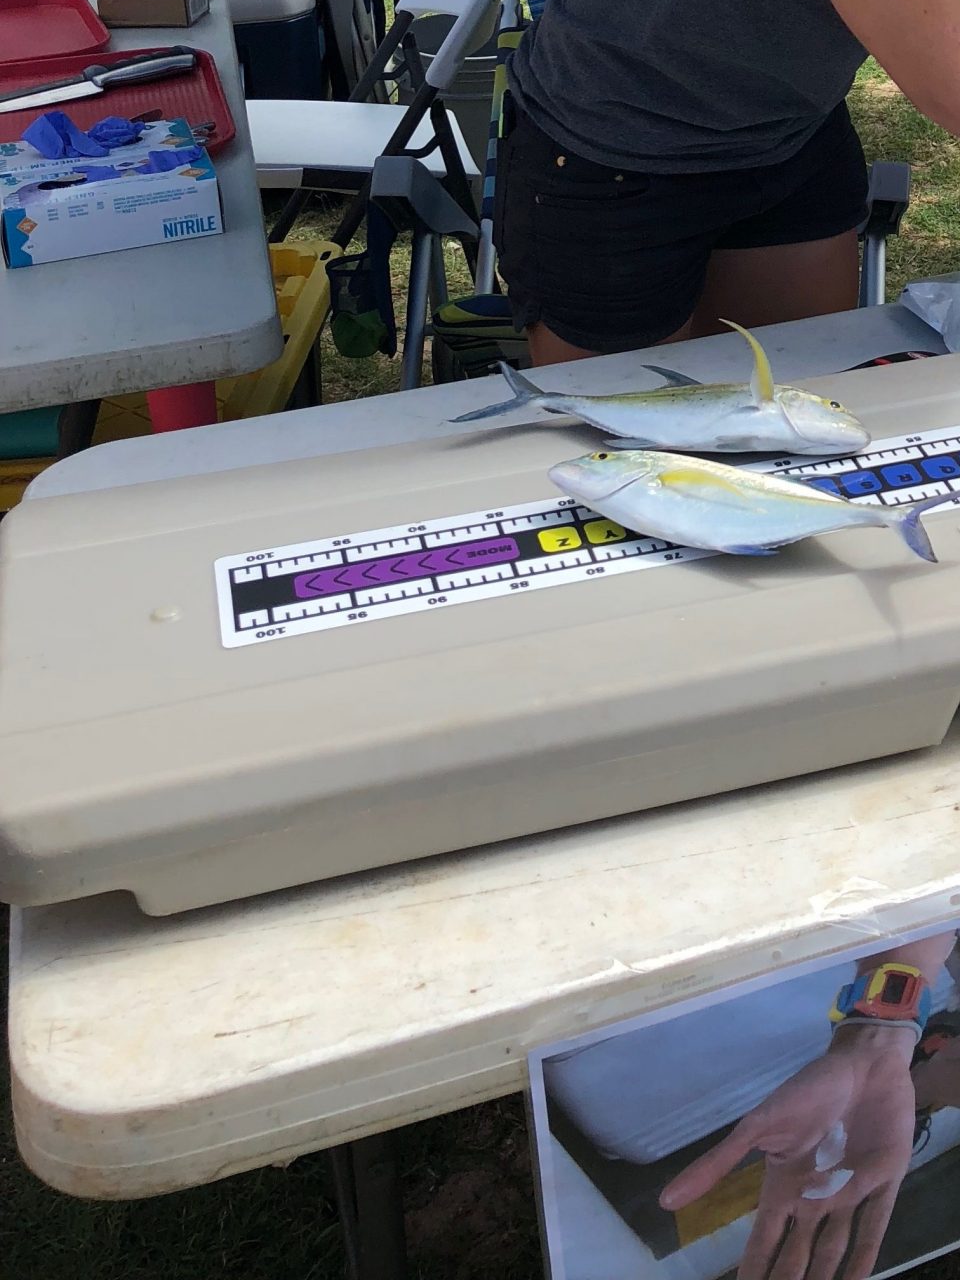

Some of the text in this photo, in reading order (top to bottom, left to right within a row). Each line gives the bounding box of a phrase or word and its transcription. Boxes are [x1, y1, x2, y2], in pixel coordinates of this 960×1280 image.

[163, 215, 217, 239] NITRILE
[558, 498, 576, 507] 80
[486, 511, 504, 519] 85
[407, 524, 427, 533] 90
[604, 529, 620, 539] Y
[332, 538, 352, 547] 95
[556, 538, 571, 548] Z
[467, 543, 513, 559] MODE
[246, 552, 275, 562] 100
[664, 552, 684, 562] 75
[586, 566, 606, 576] 80
[509, 580, 530, 590] 85
[427, 595, 448, 605] 90
[347, 611, 368, 621] 95
[256, 626, 286, 639] 100
